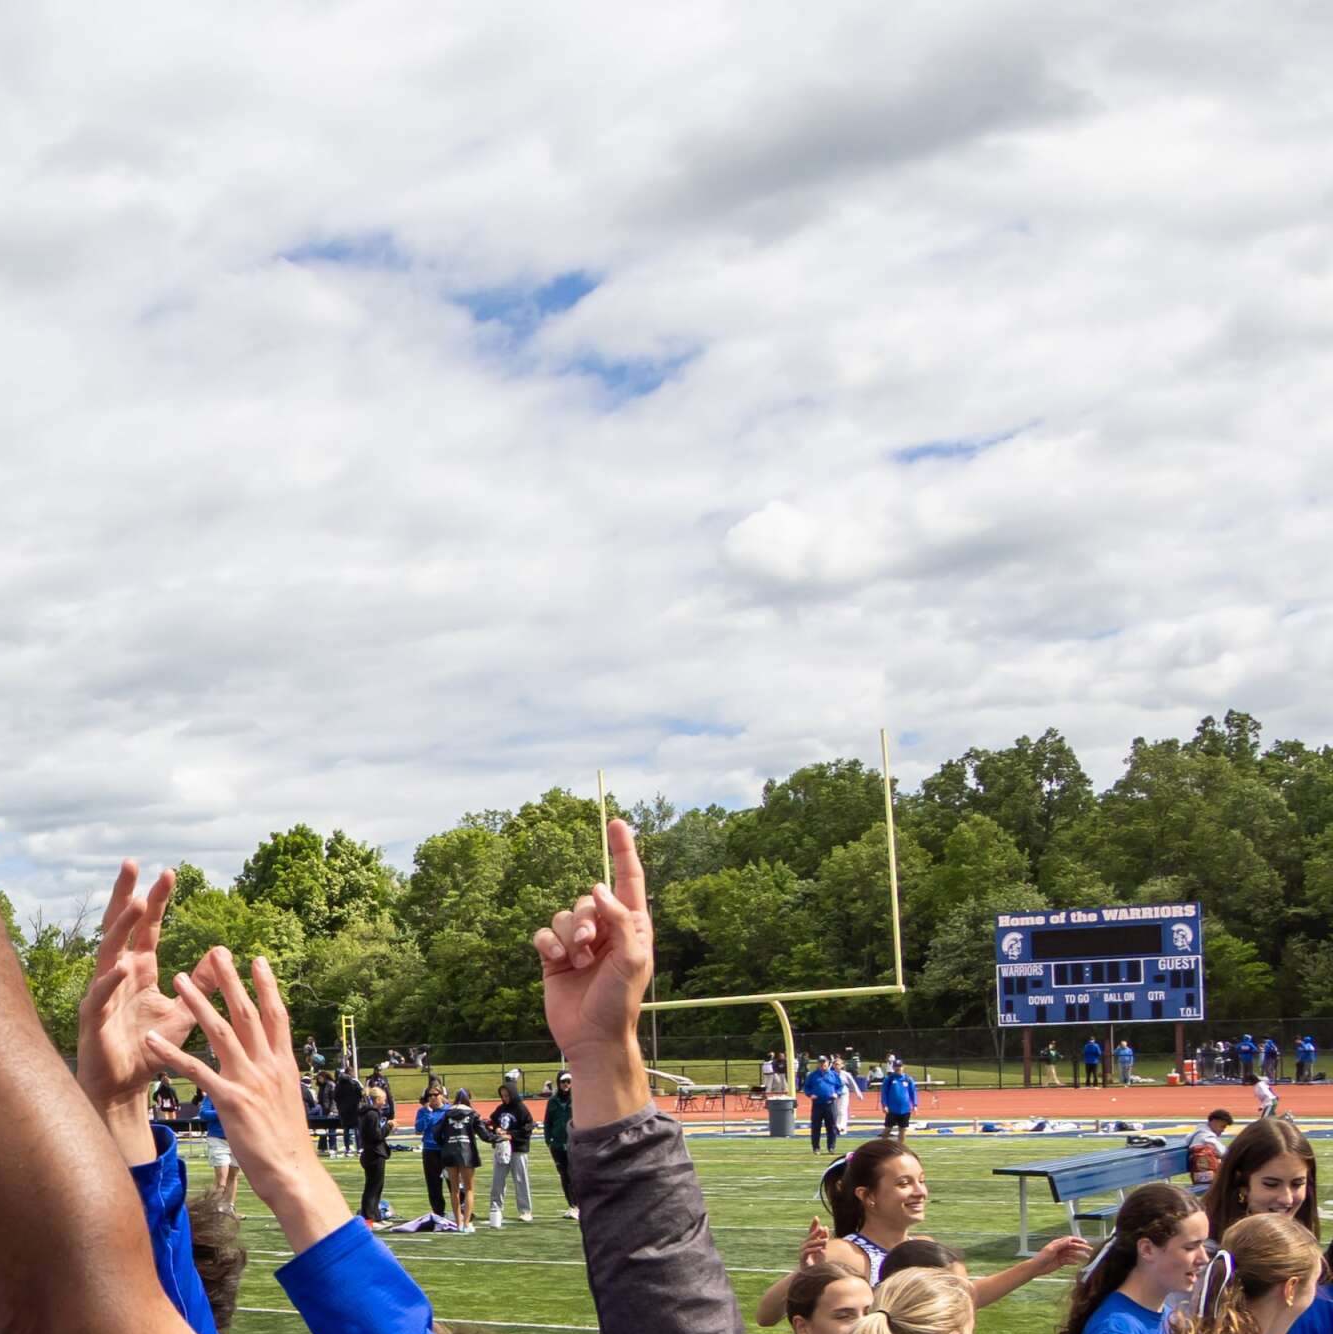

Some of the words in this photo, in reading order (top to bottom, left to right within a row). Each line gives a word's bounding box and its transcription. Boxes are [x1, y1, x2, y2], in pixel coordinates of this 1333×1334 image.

[998, 915, 1045, 928] Home
[1049, 912, 1067, 924] of
[1070, 911, 1098, 924] the
[1102, 905, 1196, 921] WARRIORS
[1158, 958, 1197, 971] GUEST
[1001, 965, 1044, 977] WARRIORS
[1028, 995, 1054, 1006] DOWN
[1065, 994, 1077, 1004] TO
[1078, 993, 1090, 1004] GO
[1103, 993, 1122, 1003] BALL
[1124, 992, 1135, 1002] ON
